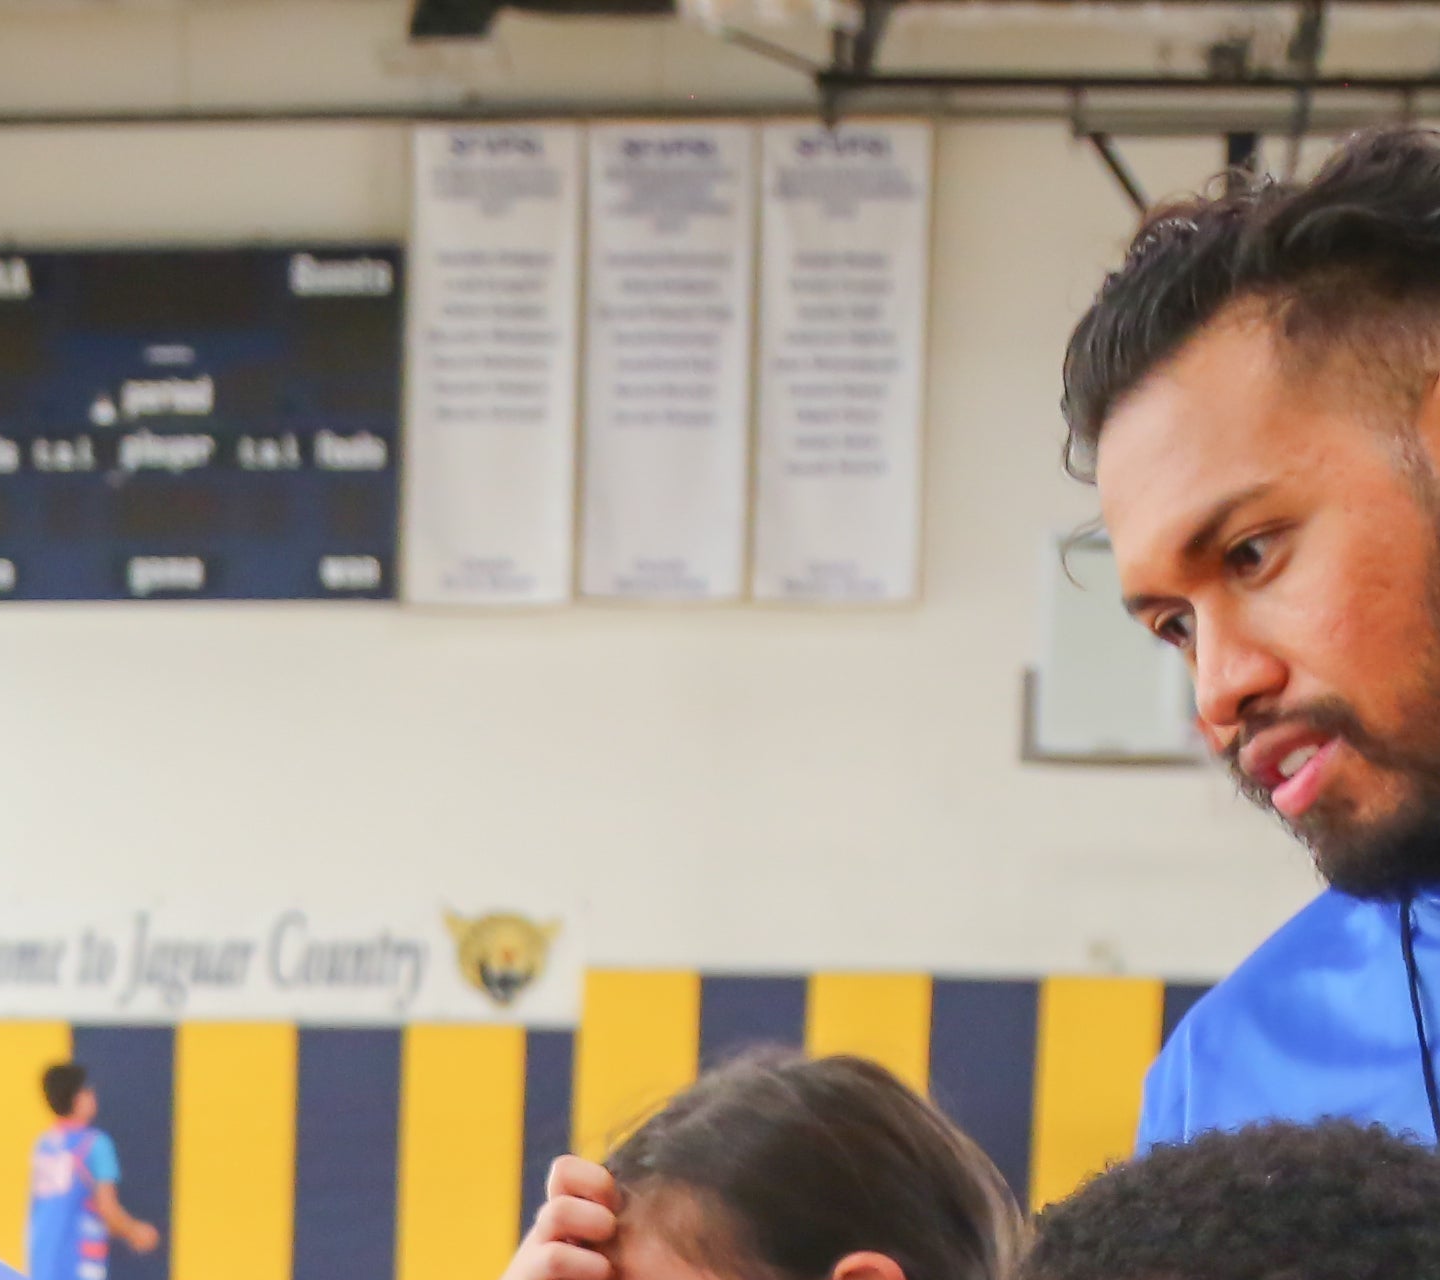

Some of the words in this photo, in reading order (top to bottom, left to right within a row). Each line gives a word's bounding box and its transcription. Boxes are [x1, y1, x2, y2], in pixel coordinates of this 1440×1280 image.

[76, 924, 118, 986] to
[118, 908, 254, 1008] Jaguar
[267, 907, 428, 1011] Country
